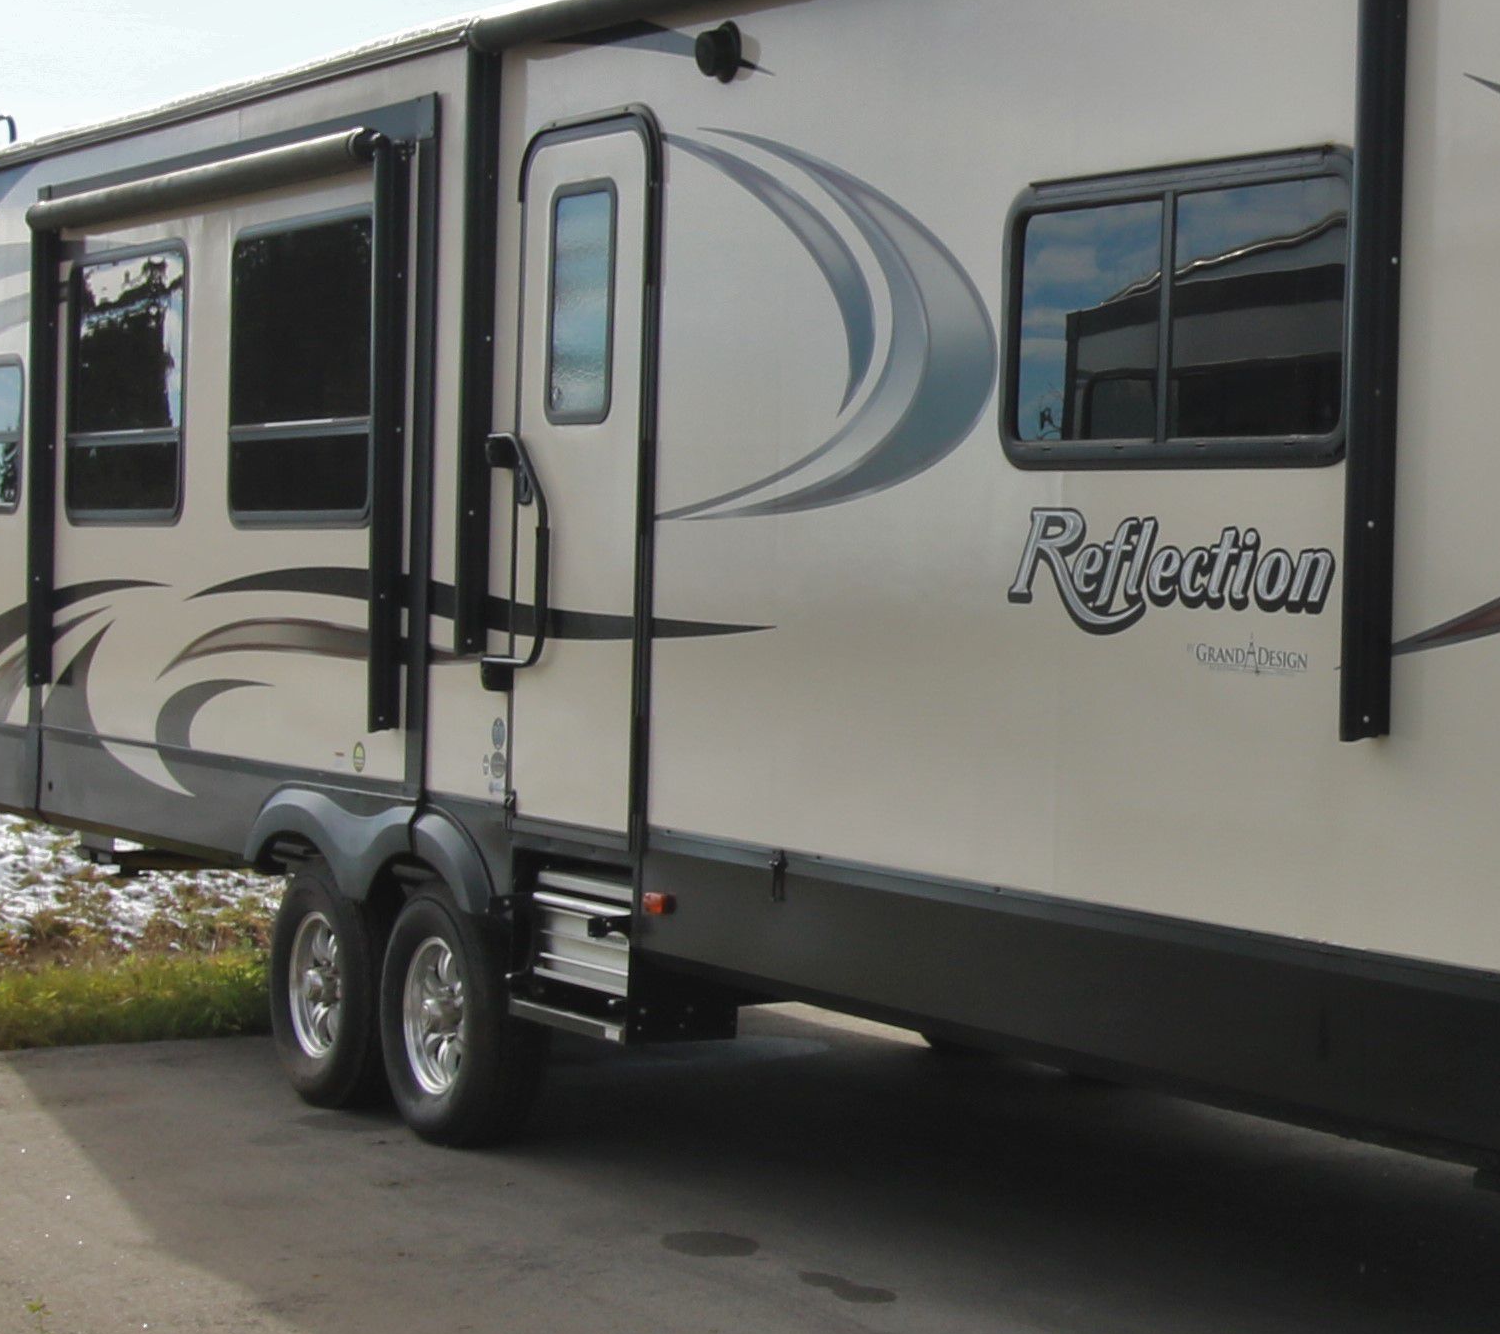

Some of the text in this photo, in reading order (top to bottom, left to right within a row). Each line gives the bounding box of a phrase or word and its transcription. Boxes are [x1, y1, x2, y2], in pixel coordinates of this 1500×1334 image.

[1007, 507, 1335, 635] Reflection
[1196, 643, 1246, 664] GRAND
[1257, 646, 1308, 669] DESIGN
